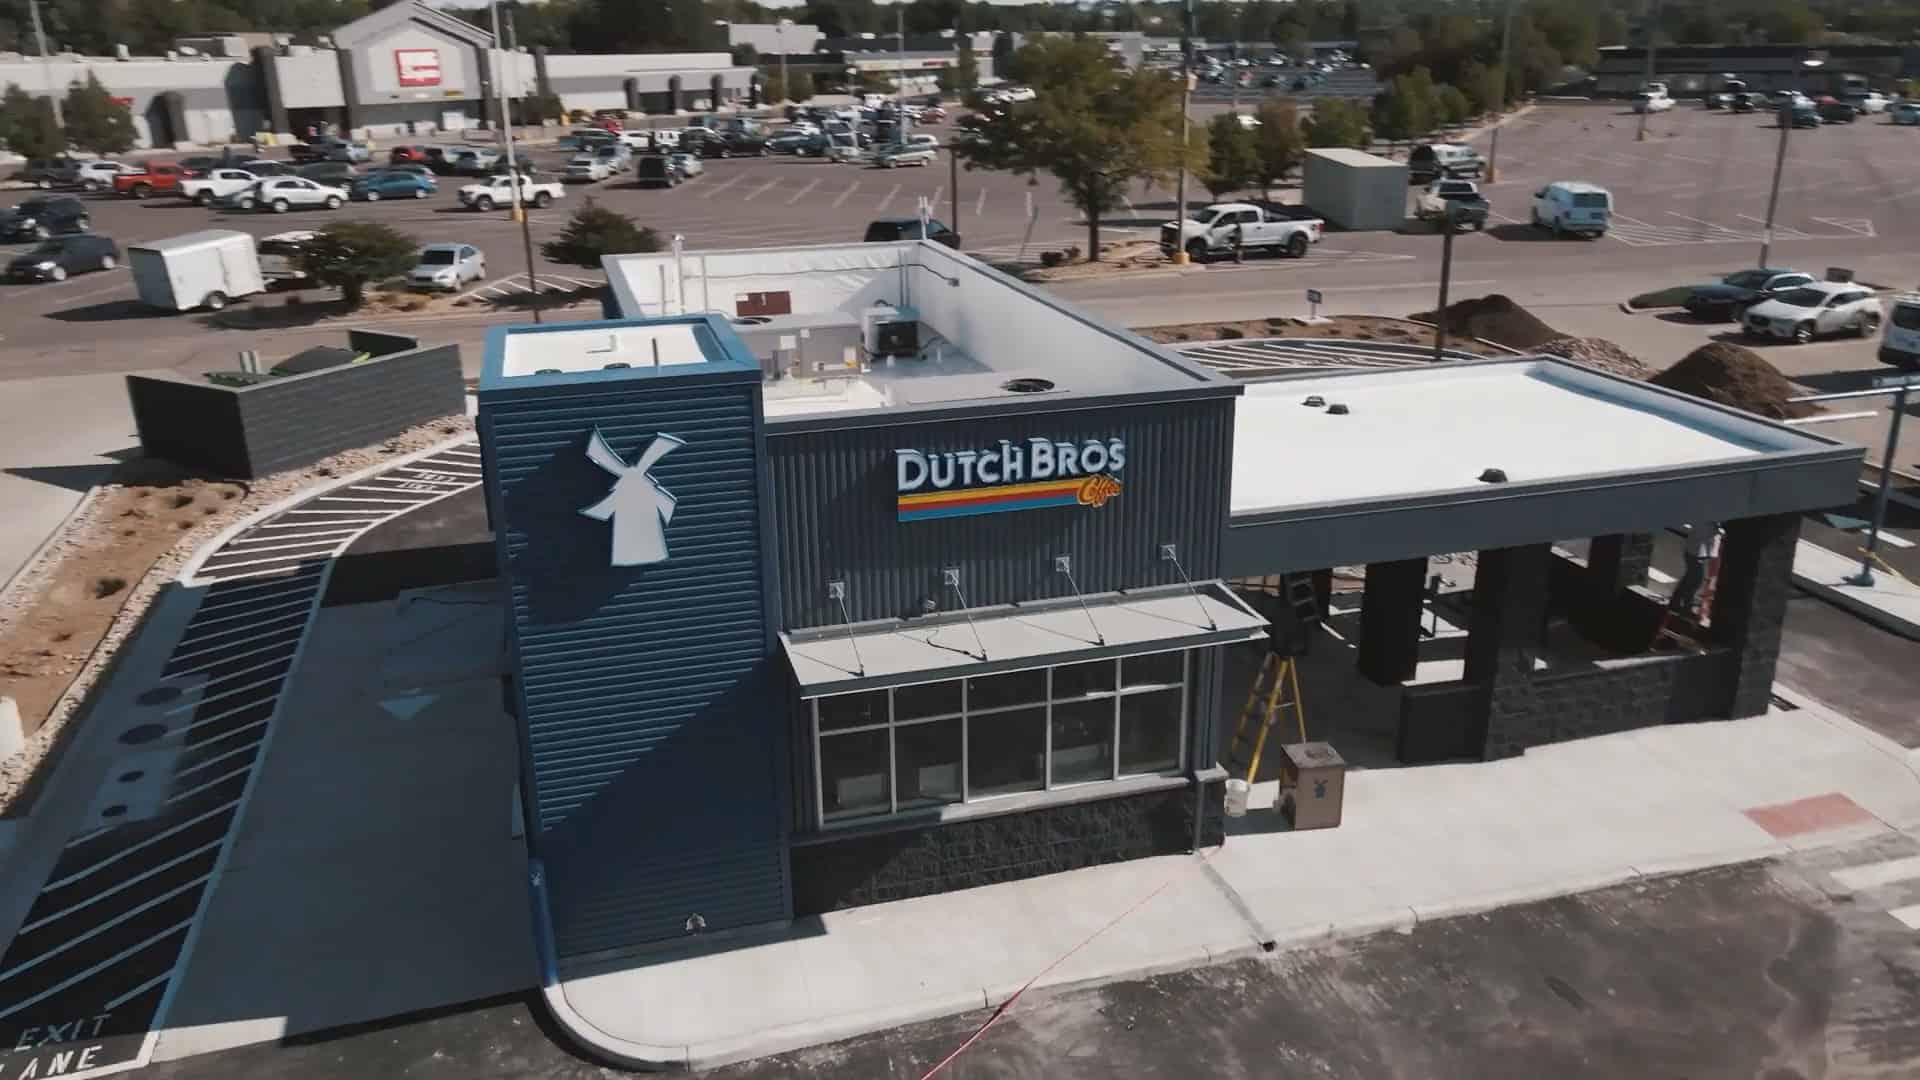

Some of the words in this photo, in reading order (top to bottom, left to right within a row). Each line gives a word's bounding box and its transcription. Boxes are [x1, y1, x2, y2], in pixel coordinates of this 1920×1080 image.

[1027, 437, 1126, 479] BROS
[14, 1014, 112, 1052] EXIT
[0, 1045, 103, 1080] ANE
